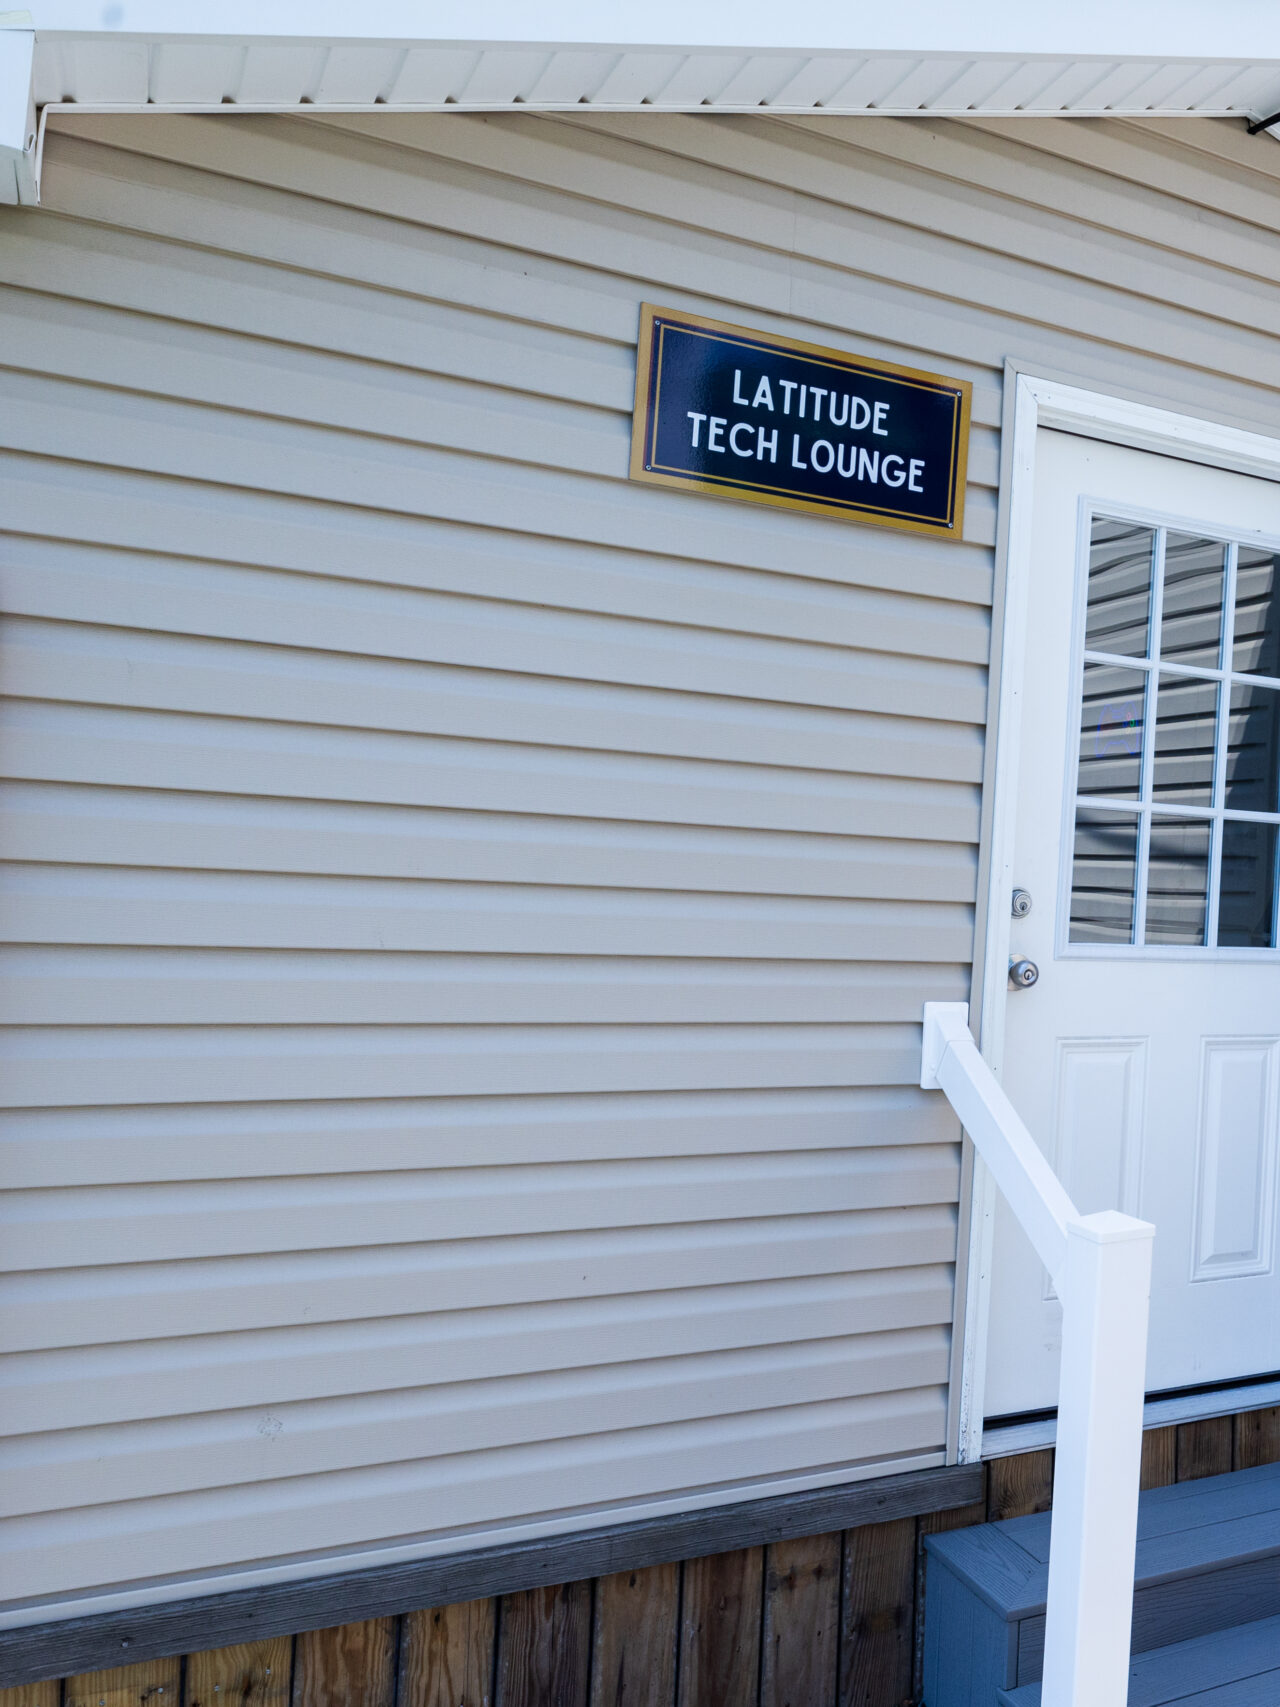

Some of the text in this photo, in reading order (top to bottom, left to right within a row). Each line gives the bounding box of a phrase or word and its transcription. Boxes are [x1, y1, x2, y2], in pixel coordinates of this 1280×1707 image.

[733, 369, 890, 436] LATITUDE
[687, 411, 925, 493] TECH LOUNGE
